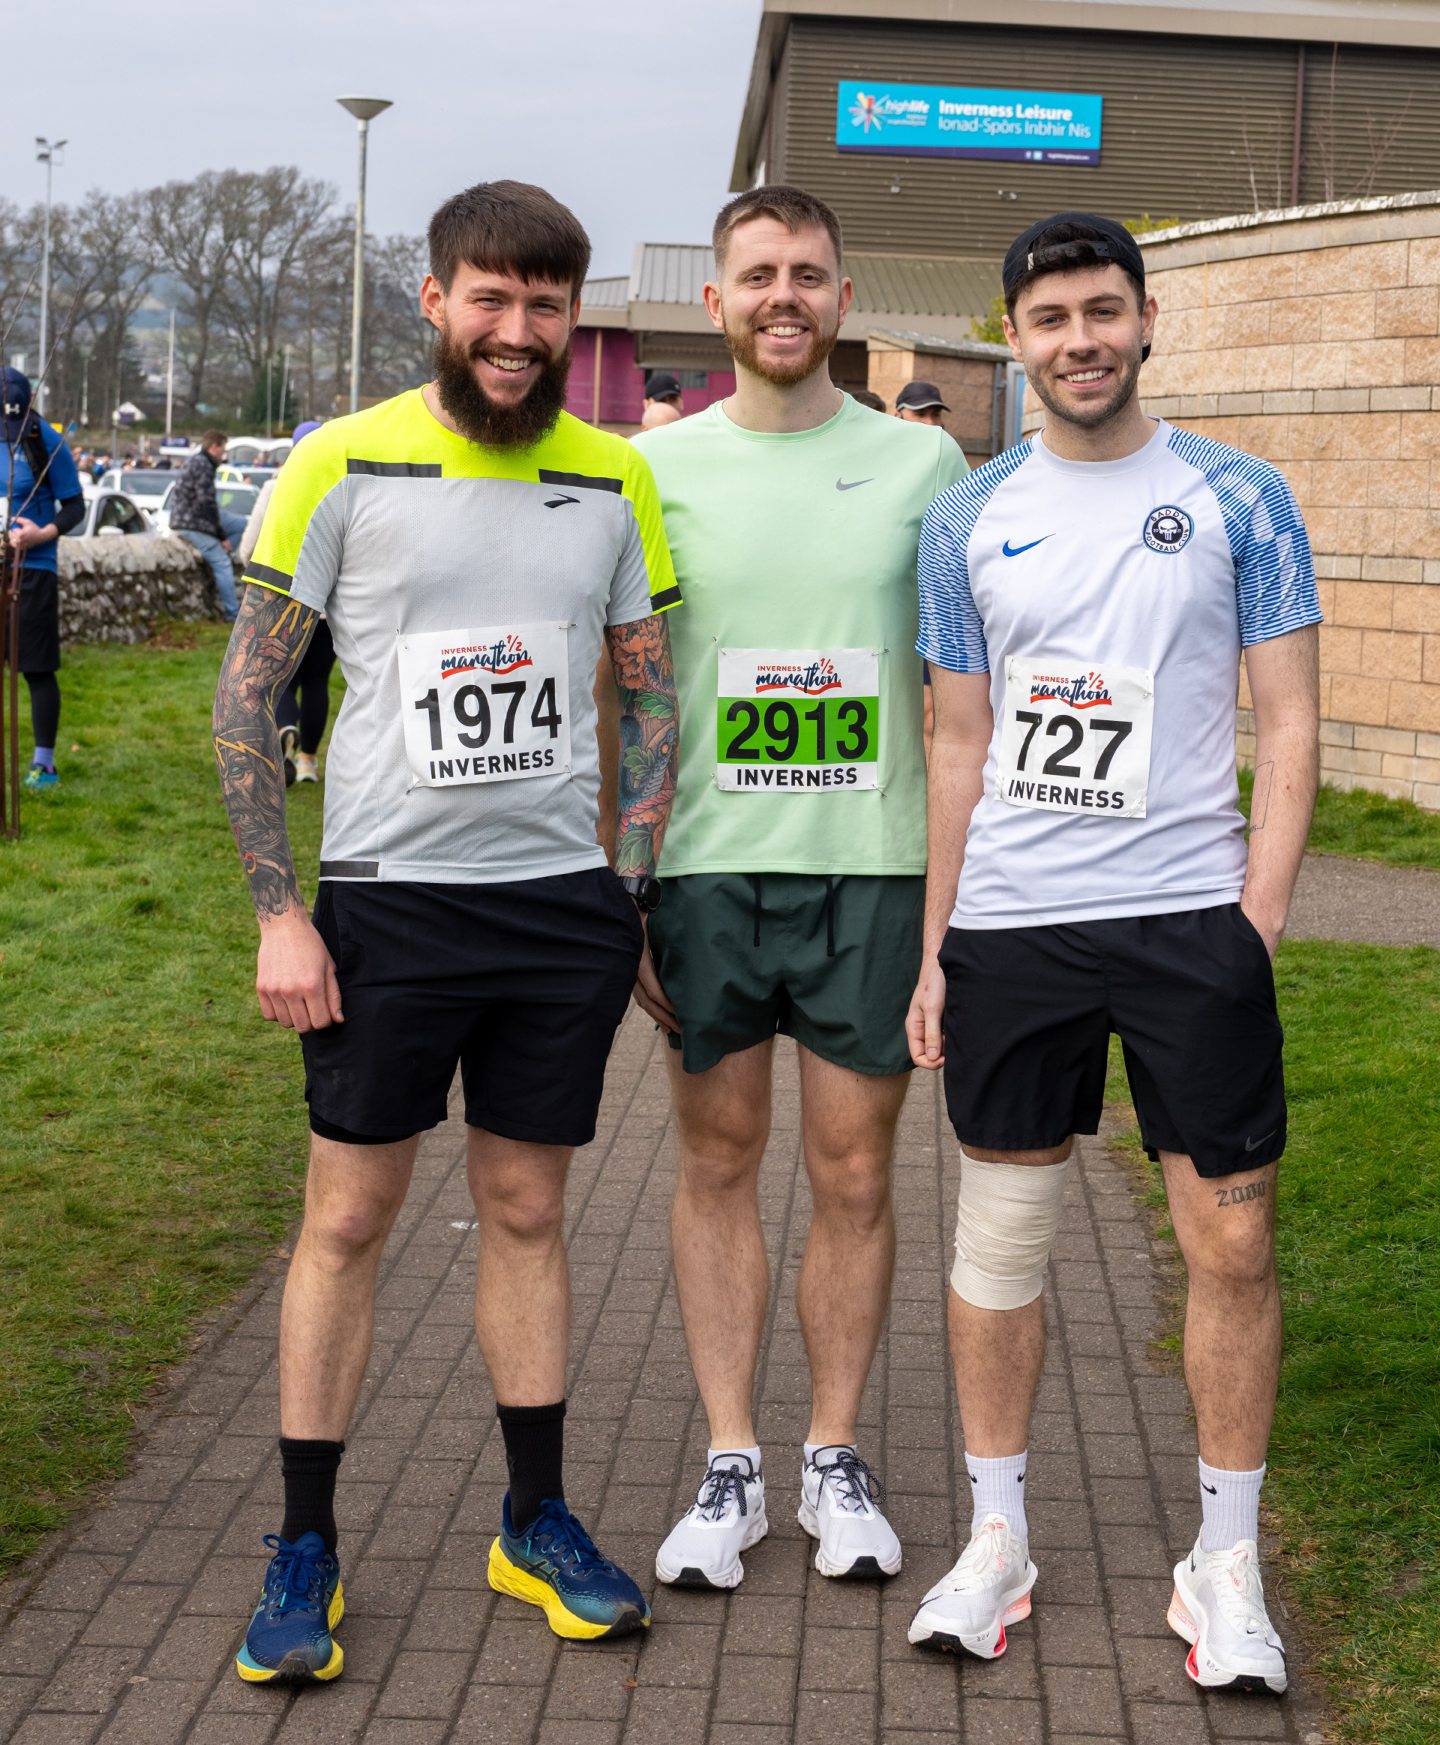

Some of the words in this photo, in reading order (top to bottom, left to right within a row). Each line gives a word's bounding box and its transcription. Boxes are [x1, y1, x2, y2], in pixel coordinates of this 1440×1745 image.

[939, 100, 1013, 118] Inverness
[1016, 104, 1073, 121] Leisure
[938, 117, 1022, 136] Ionad-Spòrs
[1024, 120, 1066, 136] Inbhir
[1068, 123, 1091, 138] Nis
[1151, 509, 1186, 521] BADDY
[1146, 531, 1178, 552] FOOTBALL
[441, 645, 487, 655] INVERNESS
[441, 640, 531, 674] marathon
[756, 662, 841, 694] marathon
[415, 677, 562, 751] 1974
[726, 700, 869, 761] 2913
[1016, 710, 1133, 780] 727
[430, 749, 554, 780] INVERNESS
[737, 767, 857, 787] INVERNESS
[1008, 779, 1125, 810] INVERNESS
